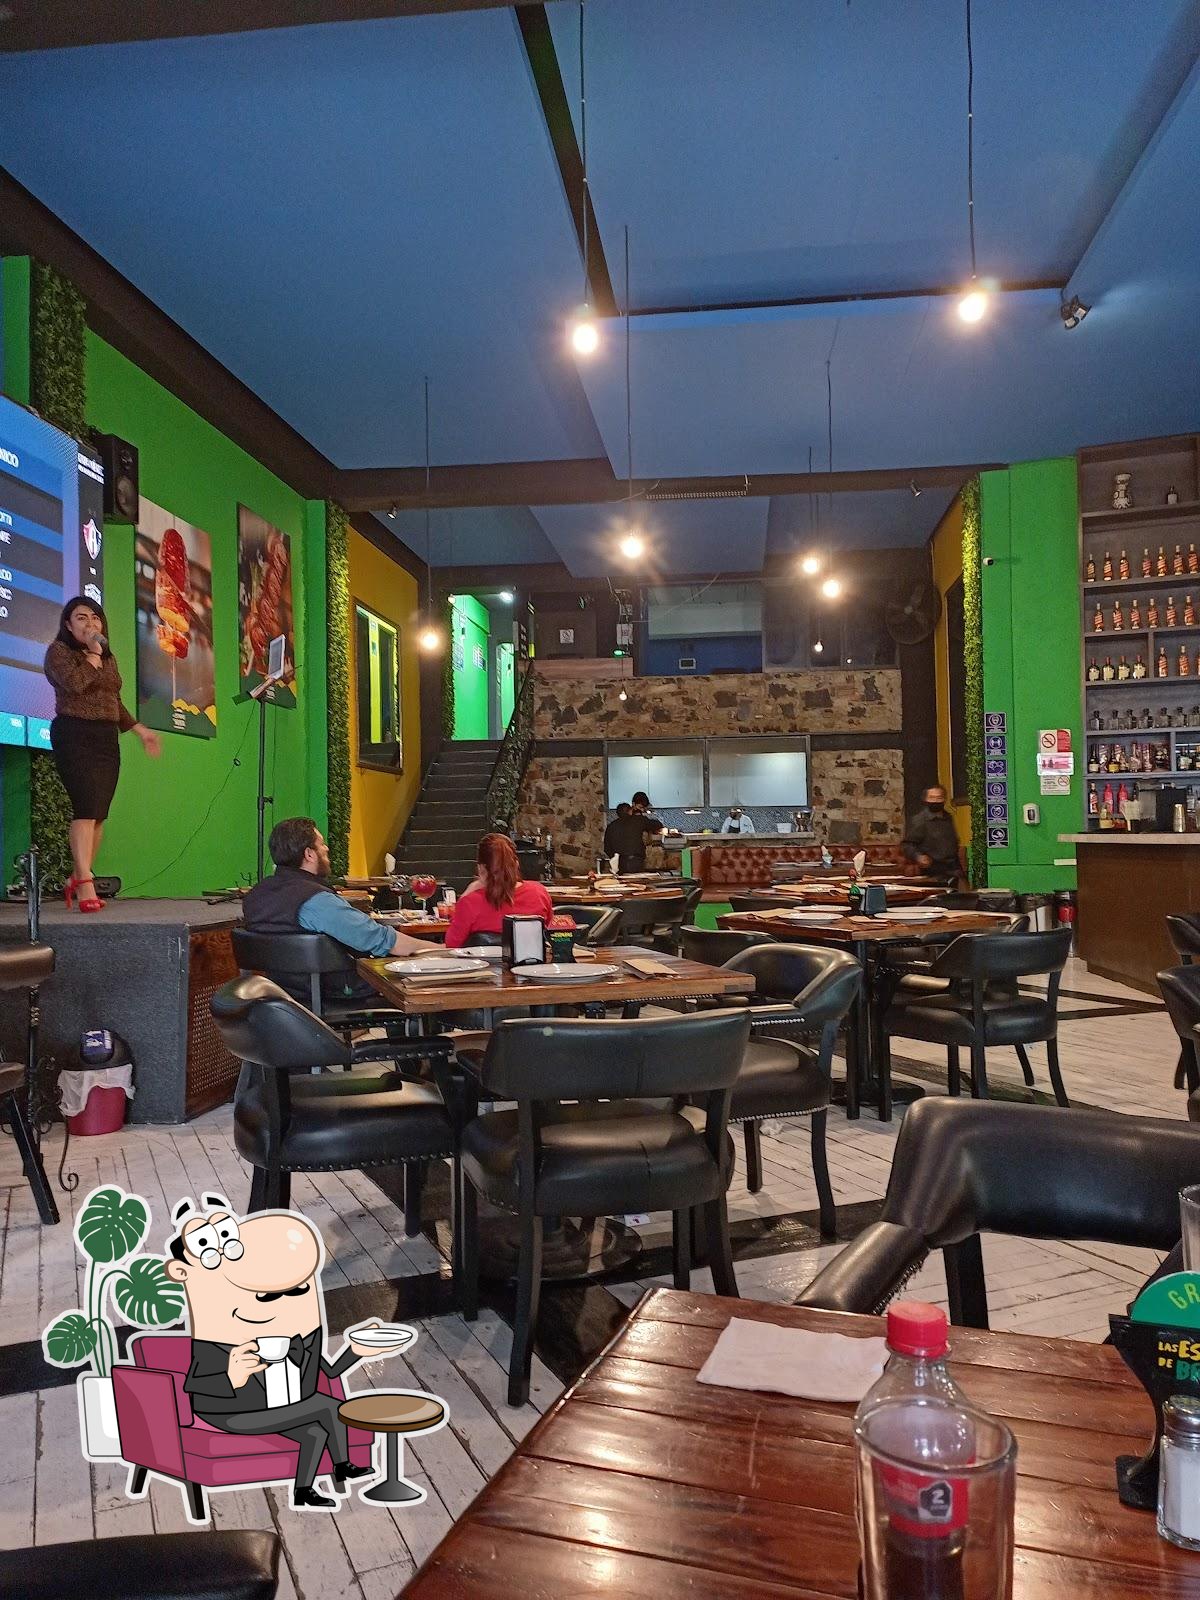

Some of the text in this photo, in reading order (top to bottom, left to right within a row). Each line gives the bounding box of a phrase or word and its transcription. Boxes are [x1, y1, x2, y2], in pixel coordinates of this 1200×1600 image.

[1158, 1341, 1178, 1353] LAS
[1158, 1357, 1173, 1369] DE
[931, 1489, 945, 1505] 2
